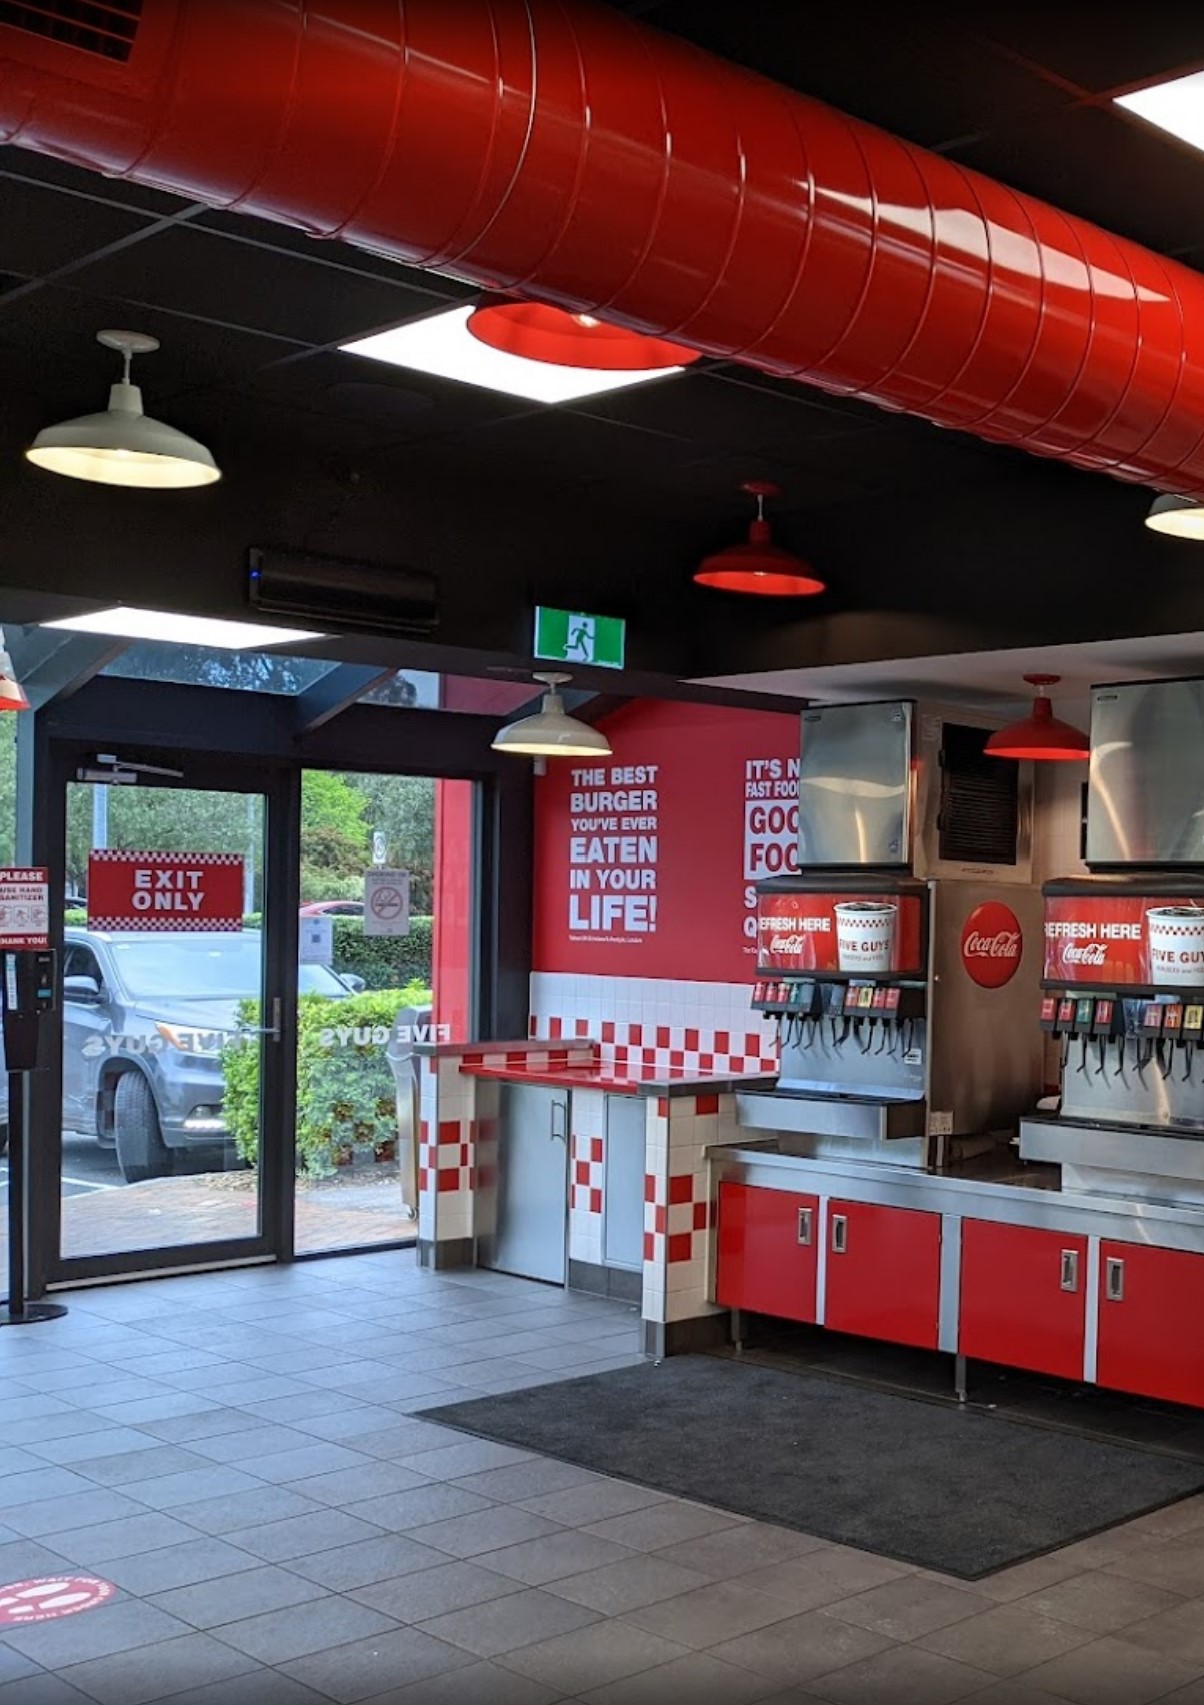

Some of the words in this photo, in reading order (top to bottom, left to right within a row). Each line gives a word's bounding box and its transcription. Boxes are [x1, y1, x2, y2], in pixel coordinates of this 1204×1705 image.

[570, 768, 605, 787] THE
[611, 765, 658, 785] BEST
[745, 759, 781, 780] IT'S
[745, 781, 773, 798] FAST
[774, 781, 799, 797] FOO
[569, 790, 658, 813] BURGER
[571, 818, 617, 832] YOU'VE
[621, 816, 657, 831] EVER
[749, 806, 799, 835] GOO
[569, 835, 657, 864] EATEN
[749, 843, 799, 873] FOO
[0, 871, 44, 881] PLEASE
[133, 869, 204, 889] EXIT
[569, 869, 590, 890] IN
[596, 869, 656, 890] YOUR
[131, 892, 205, 911] ONLY
[568, 894, 657, 932] LIFE!
[759, 916, 797, 932] EFRESH
[799, 917, 831, 932] HERE
[1100, 923, 1142, 940] HERE
[0, 936, 25, 945] HANK
[861, 940, 889, 952] GUYS
[1152, 948, 1175, 963] FIVE
